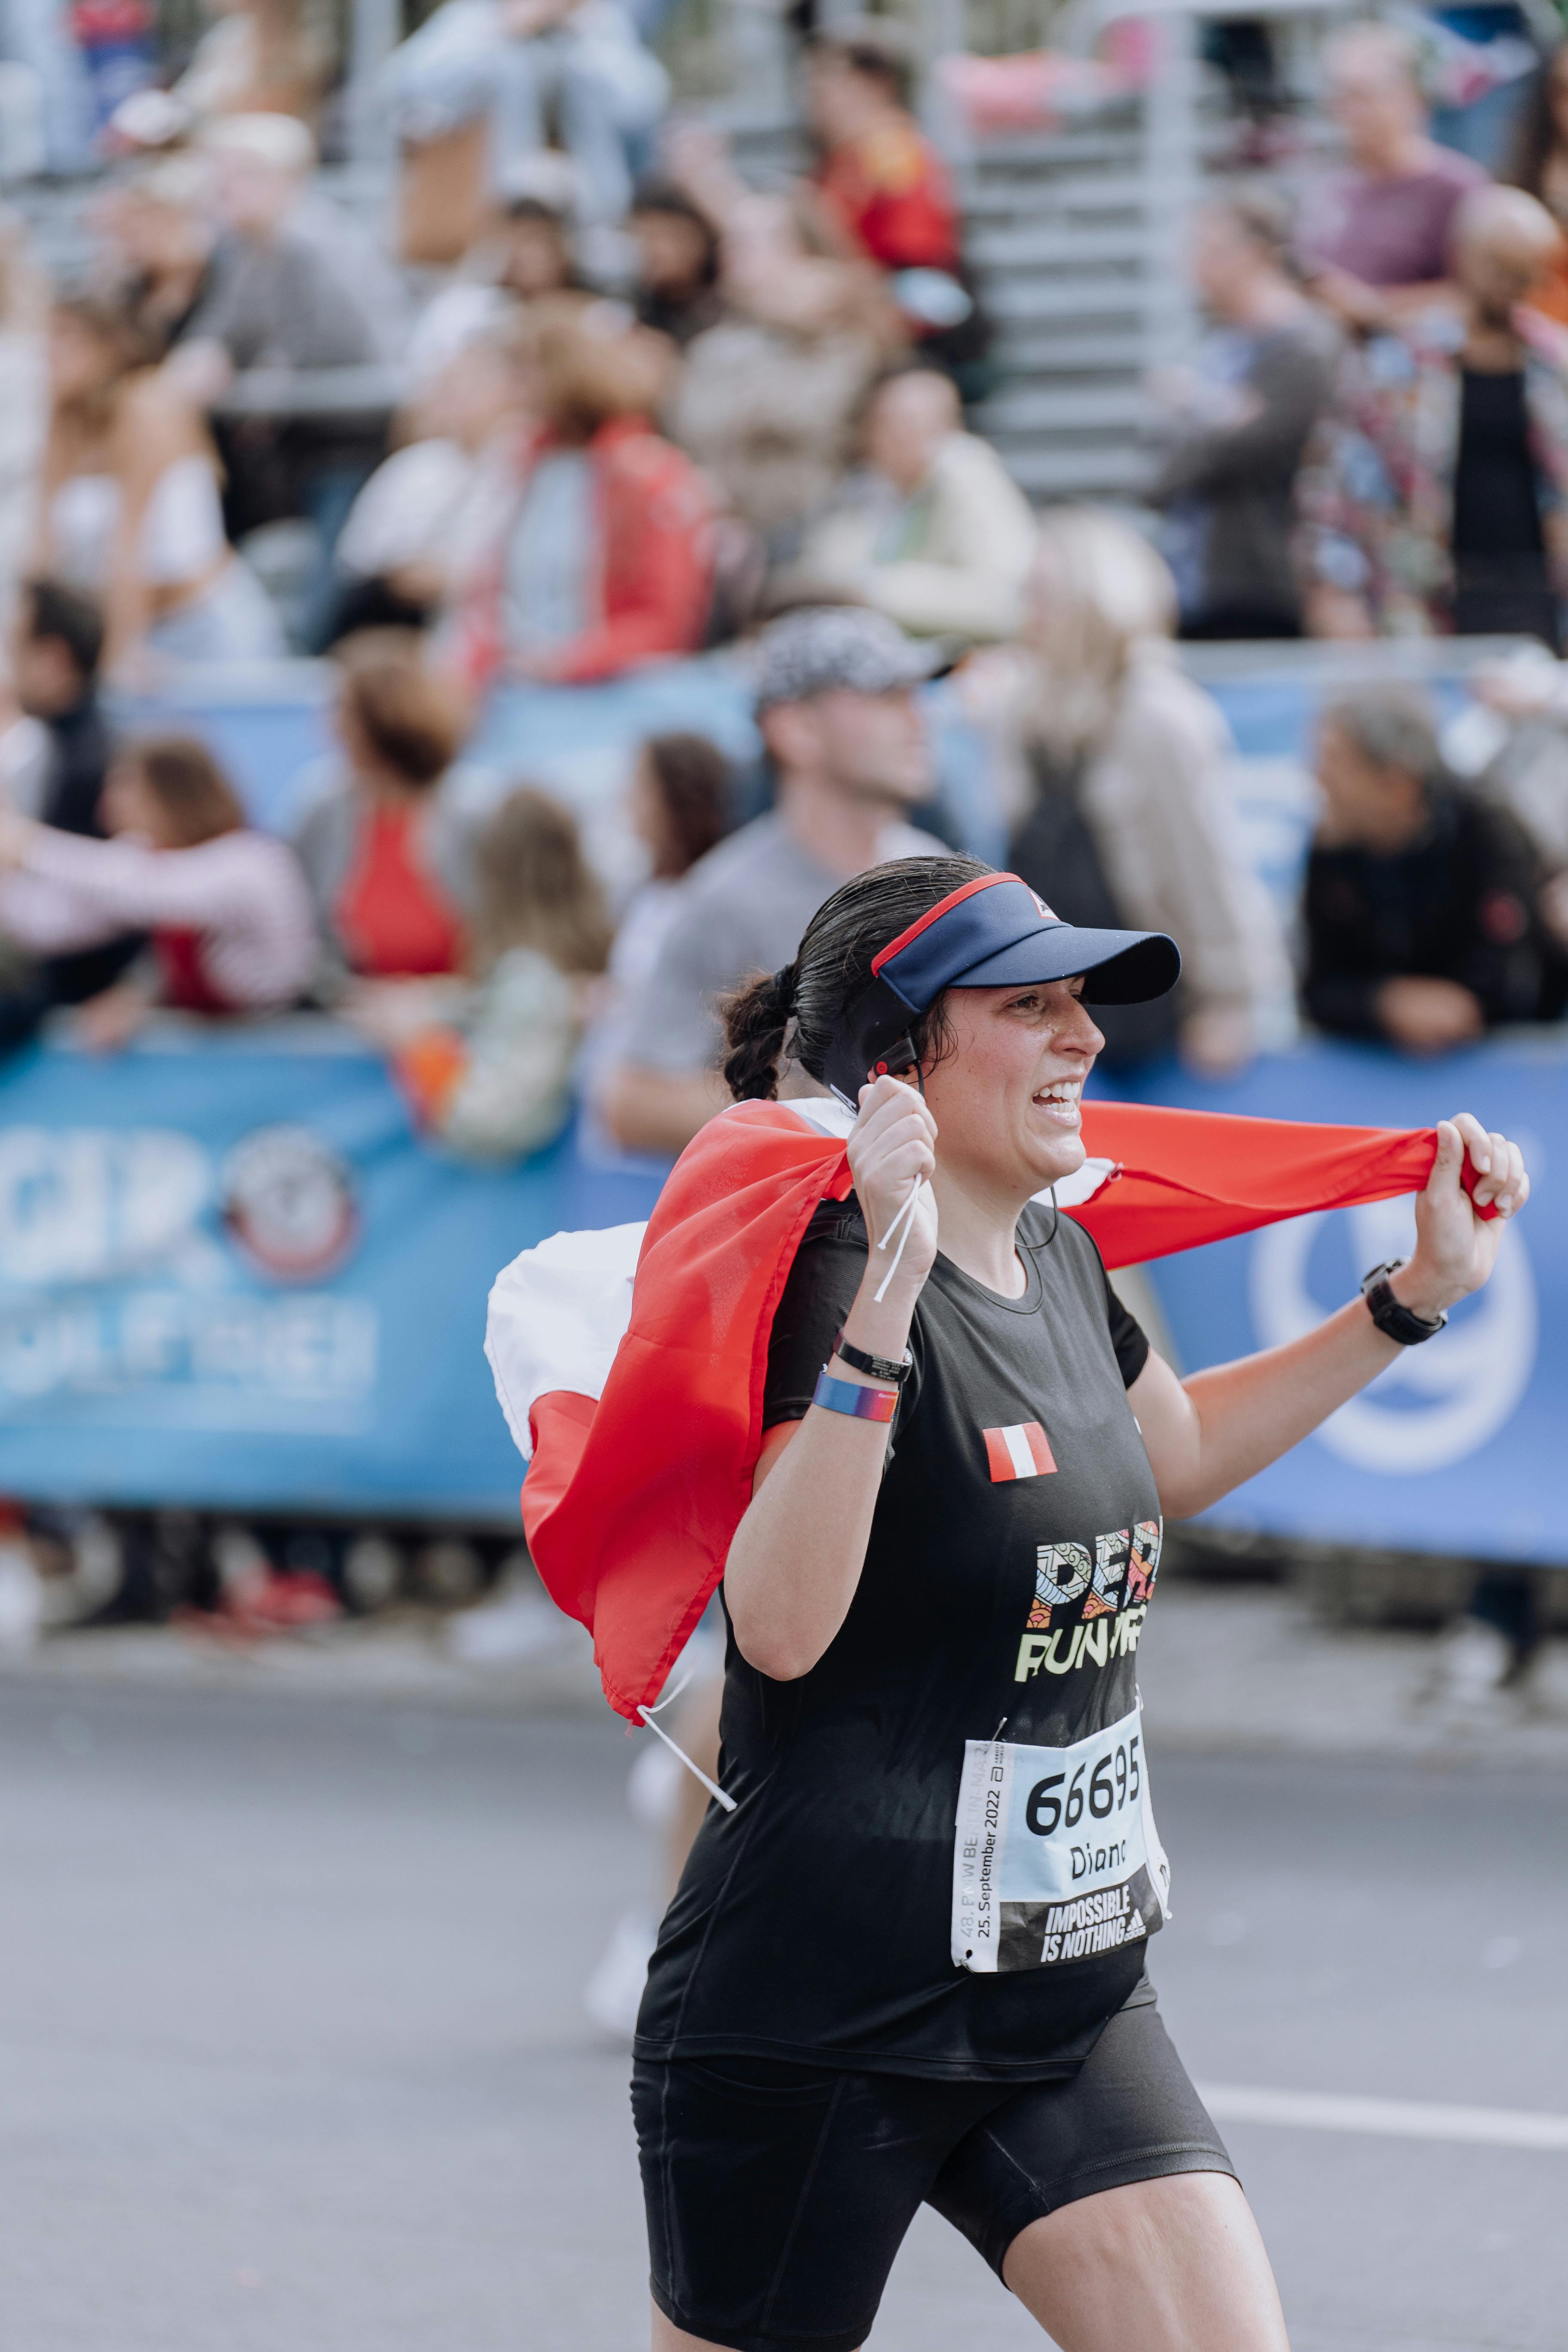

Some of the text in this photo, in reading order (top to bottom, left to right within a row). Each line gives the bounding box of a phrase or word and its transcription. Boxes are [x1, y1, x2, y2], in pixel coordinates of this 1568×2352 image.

[1026, 1515, 1162, 1629] PER
[1026, 1735, 1139, 1836] 66695
[962, 1863, 974, 1906] BW
[978, 1790, 1000, 1938] 25. September 2022
[1045, 1884, 1130, 1934] IMPOSSIBLE
[1124, 1925, 1146, 1942] adidas
[1040, 1916, 1126, 1963] IS NOTHING
